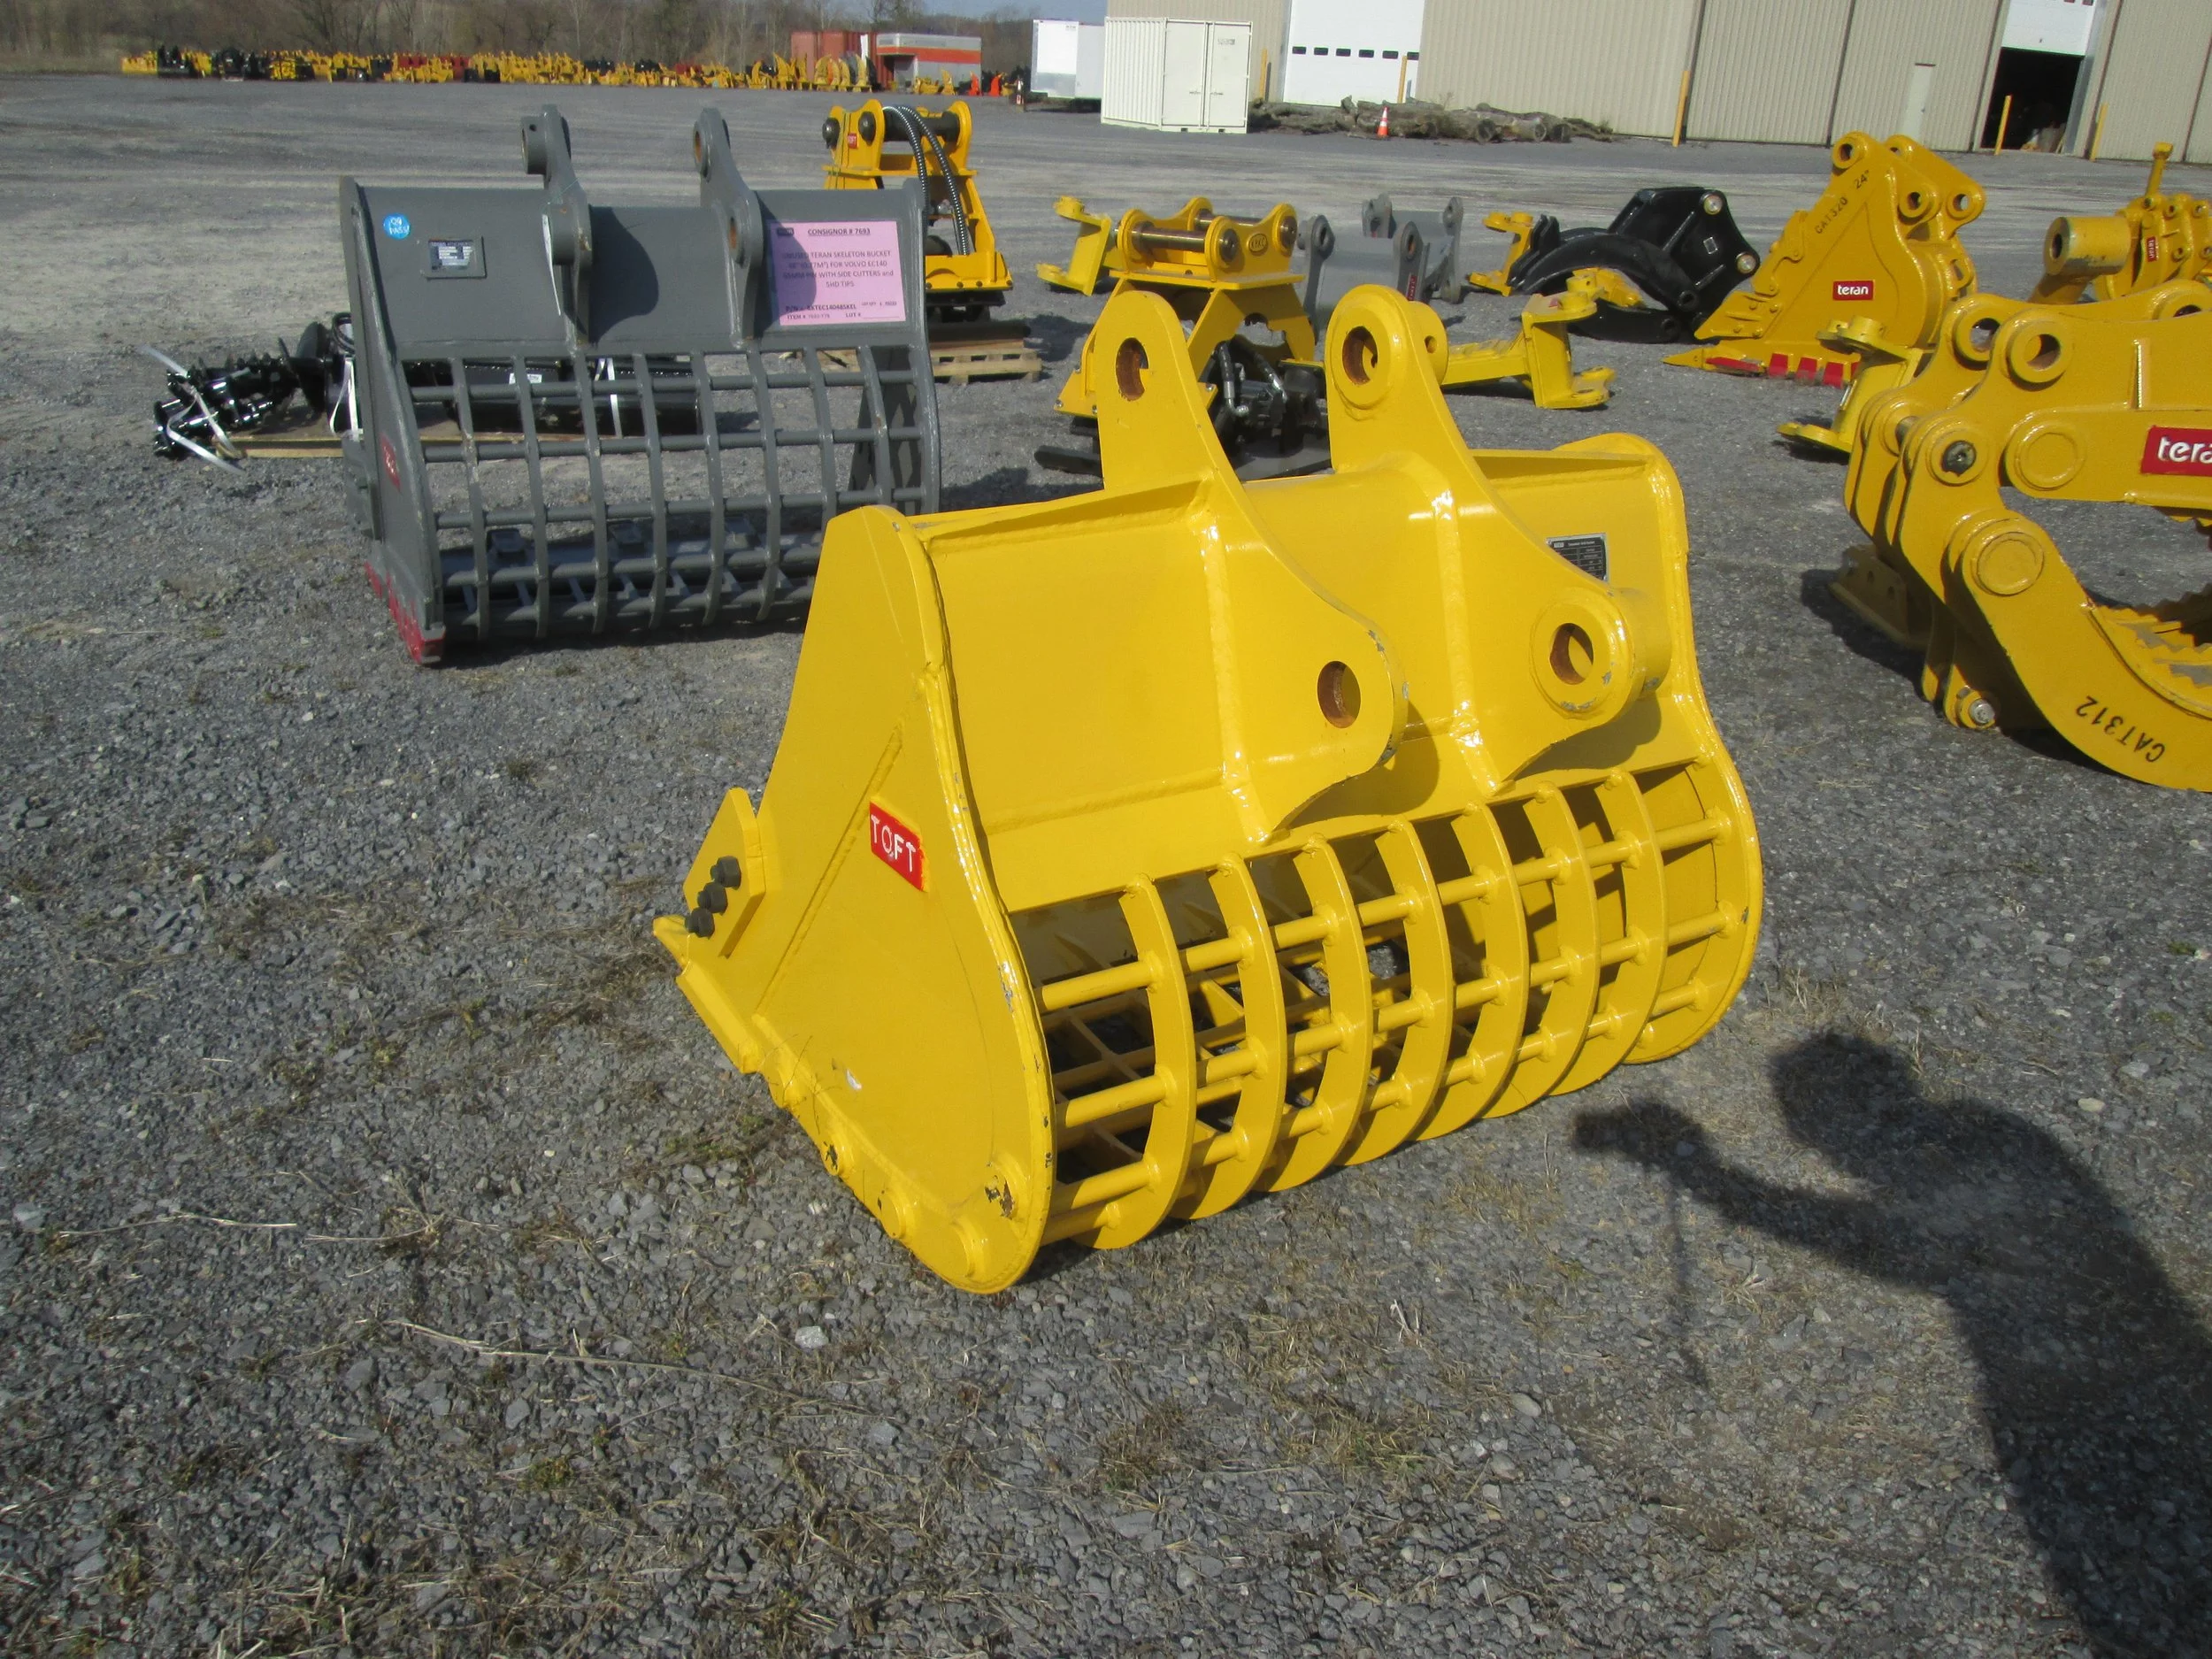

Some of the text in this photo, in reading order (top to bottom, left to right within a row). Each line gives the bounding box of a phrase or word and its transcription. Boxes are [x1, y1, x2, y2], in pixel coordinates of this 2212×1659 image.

[1814, 169, 1870, 234] CAT320 24"
[1837, 285, 1869, 296] teran
[2076, 695, 2166, 763] CAT312
[871, 813, 917, 873] TOFT
